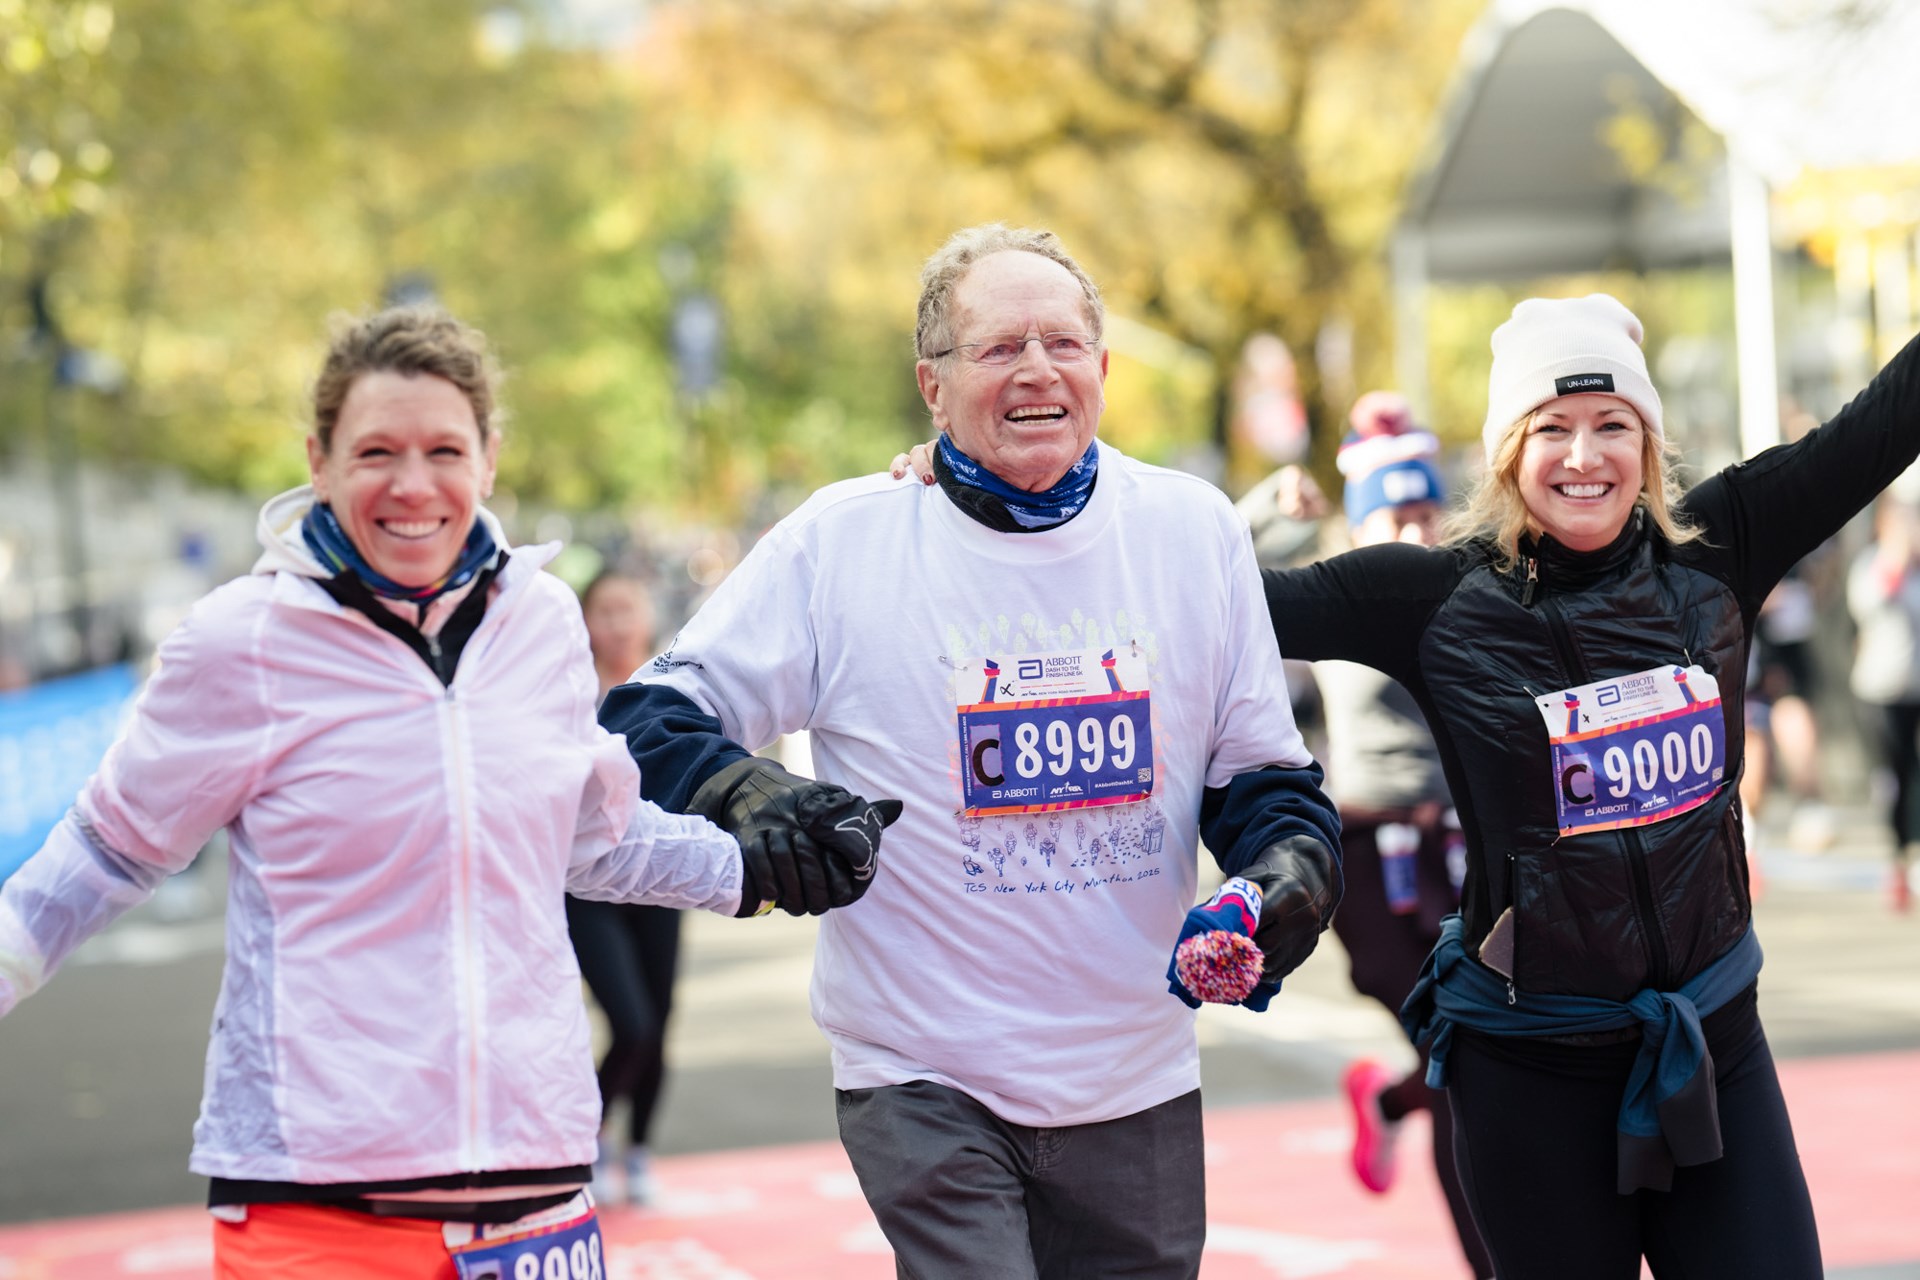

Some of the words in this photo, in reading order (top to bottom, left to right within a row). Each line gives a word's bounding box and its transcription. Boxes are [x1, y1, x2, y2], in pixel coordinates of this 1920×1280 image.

[1567, 378, 1604, 388] UN-LEARN
[1045, 656, 1082, 666] ABBOTT
[1621, 676, 1655, 690] ABBOTT
[972, 738, 1005, 787] C
[1015, 714, 1136, 779] 8999
[1562, 764, 1594, 805] C
[1603, 724, 1713, 798] 9000
[1003, 787, 1039, 798] ABBOTT
[1596, 803, 1629, 815] ABBOTT
[964, 882, 986, 893] TCS
[994, 883, 1016, 893] New
[1025, 882, 1048, 893] York
[1054, 880, 1075, 893] City
[1083, 873, 1133, 891] Marathon
[1137, 867, 1161, 880] 2025
[514, 1232, 602, 1280] 8998
